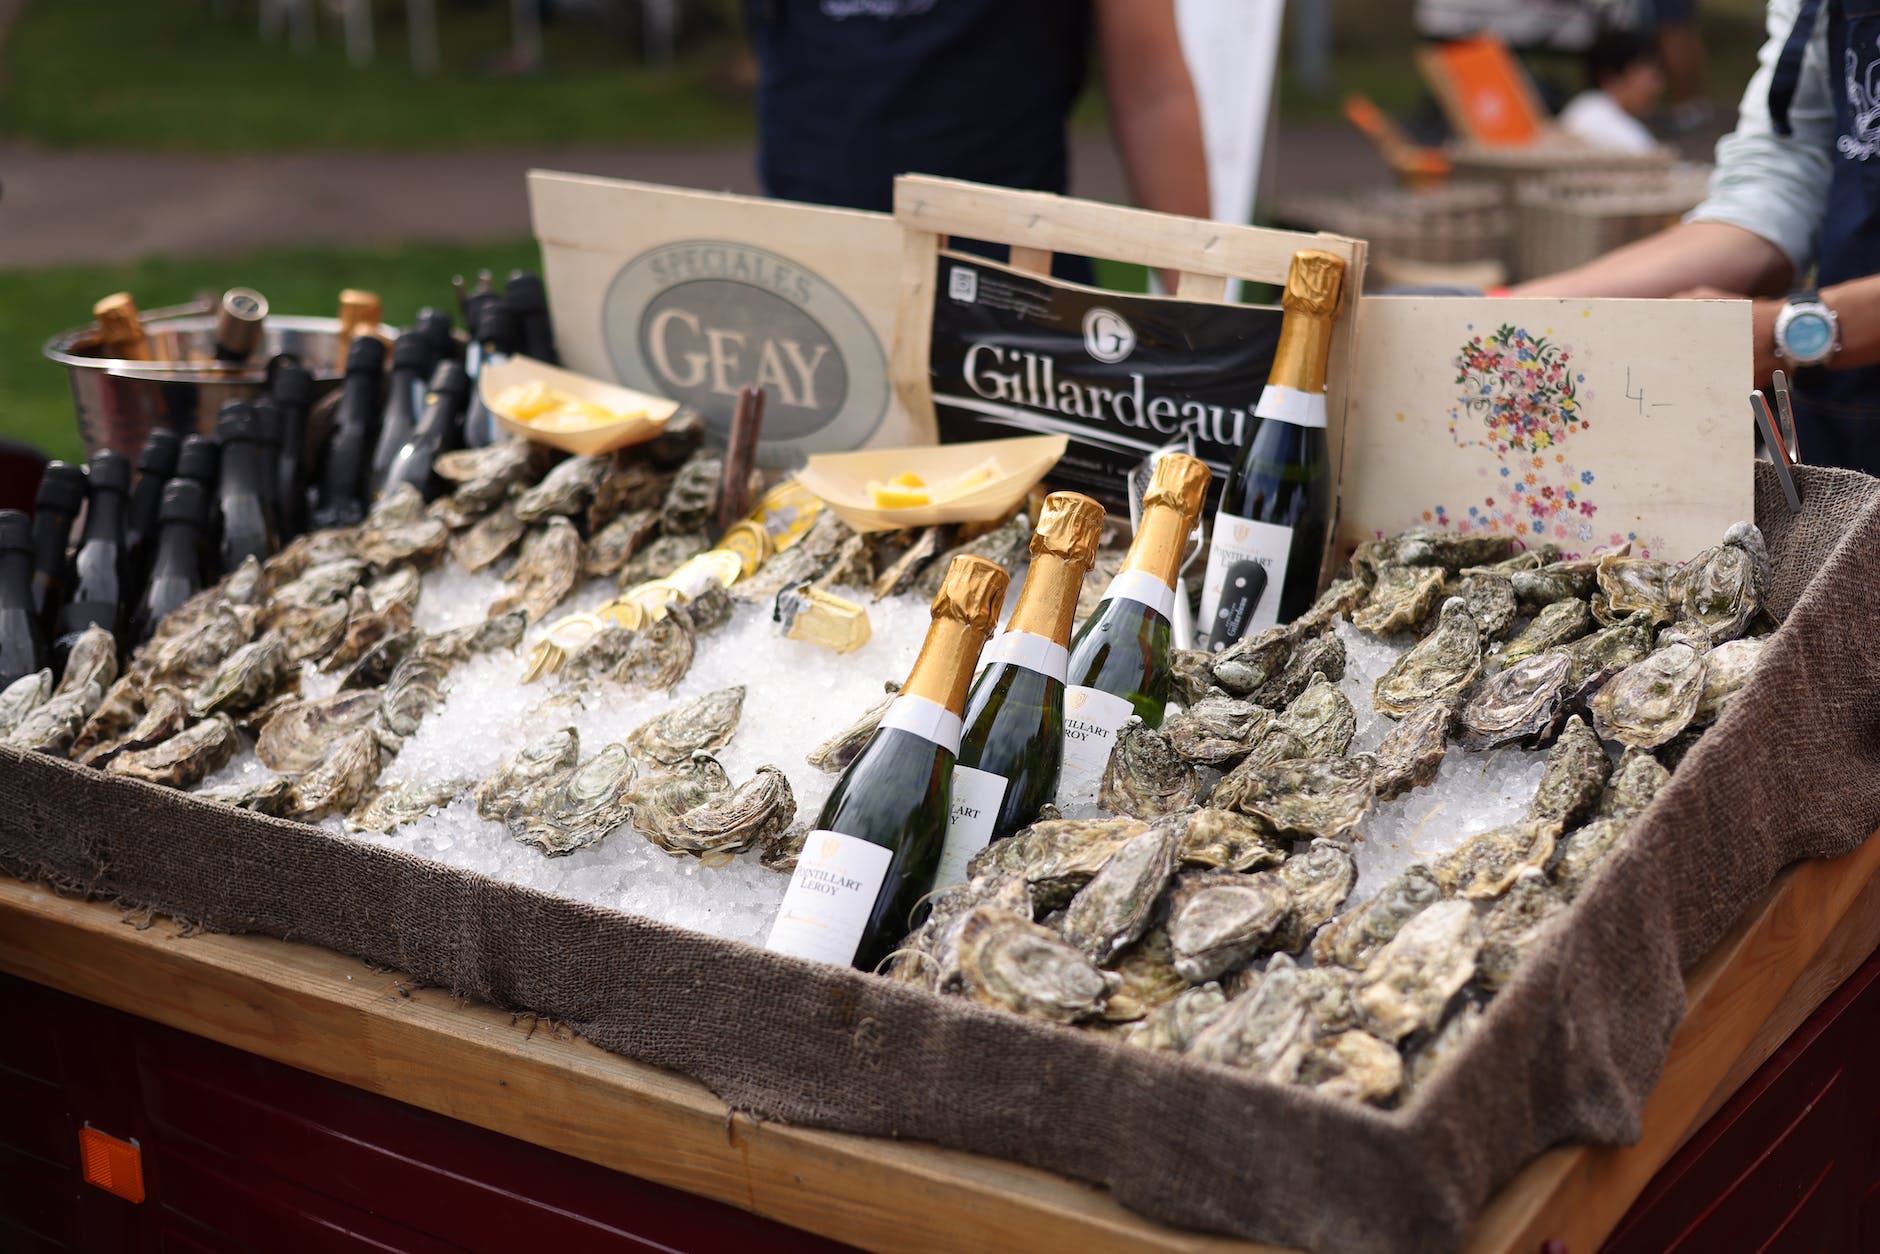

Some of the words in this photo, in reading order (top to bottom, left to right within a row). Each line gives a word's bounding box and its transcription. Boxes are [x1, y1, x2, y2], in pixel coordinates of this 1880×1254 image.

[650, 247, 812, 304] SPECIALES
[649, 308, 829, 411] GEAY
[1090, 312, 1130, 354] G
[963, 343, 1246, 447] Gillardeau
[800, 876, 840, 896] LEROY
